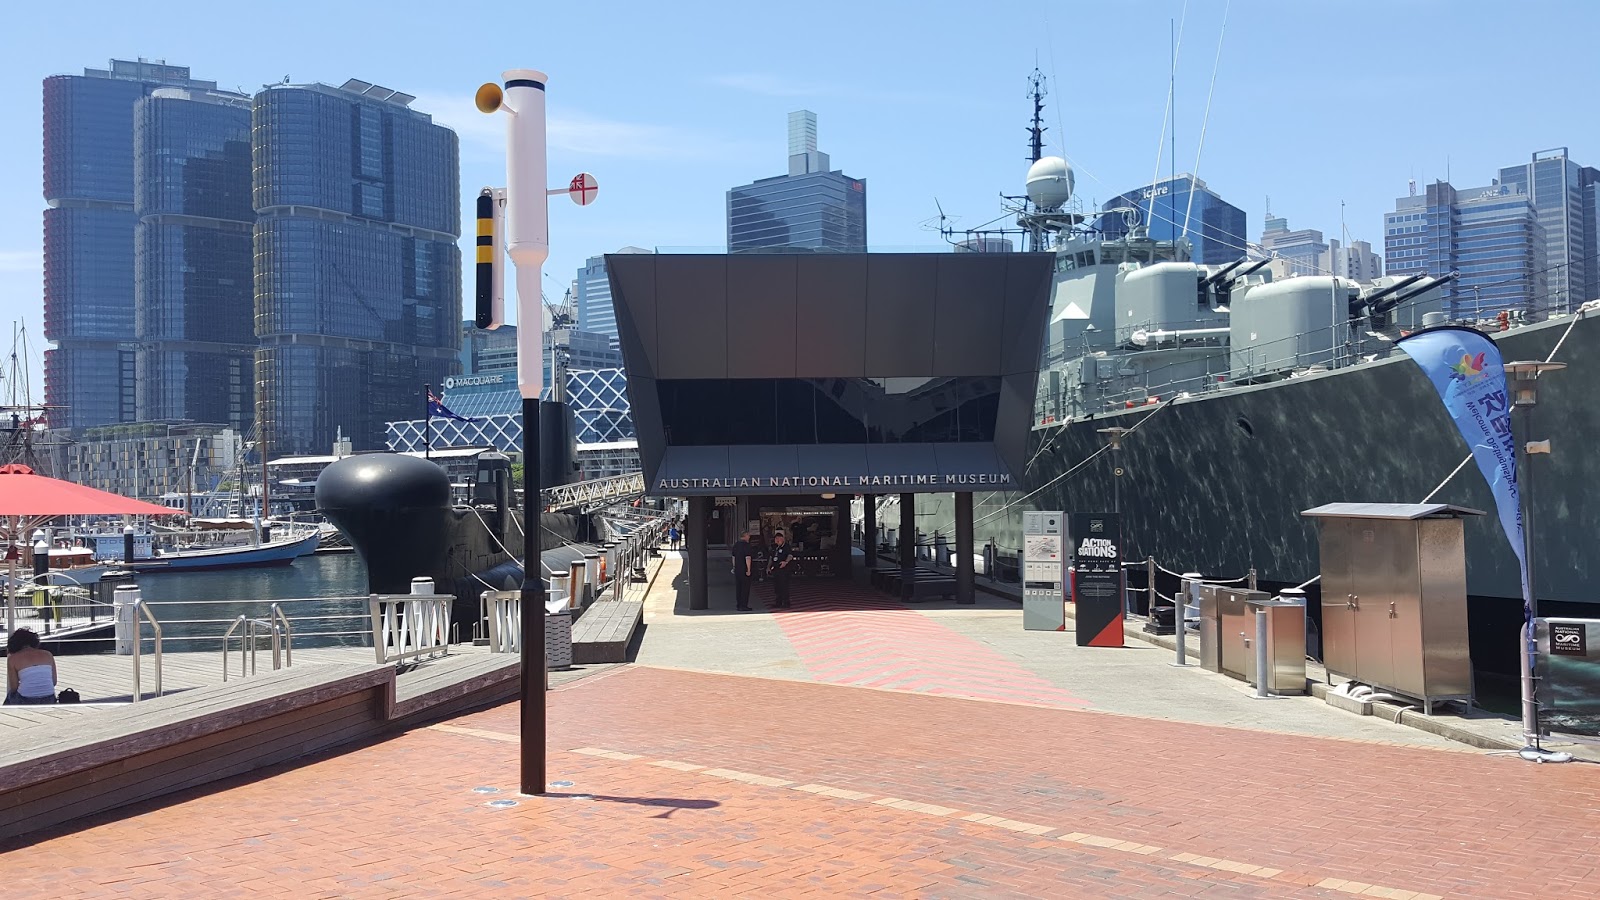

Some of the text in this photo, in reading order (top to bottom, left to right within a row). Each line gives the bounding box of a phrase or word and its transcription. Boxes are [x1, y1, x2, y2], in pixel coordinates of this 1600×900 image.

[1480, 189, 1499, 198] ANZ
[456, 375, 503, 387] MACQUARIE
[659, 473, 1010, 489] AUSTRALIAN NATIONAL MARITIME MUSEUM
[1082, 538, 1111, 548] ACTION
[1078, 545, 1117, 558] STATIONS
